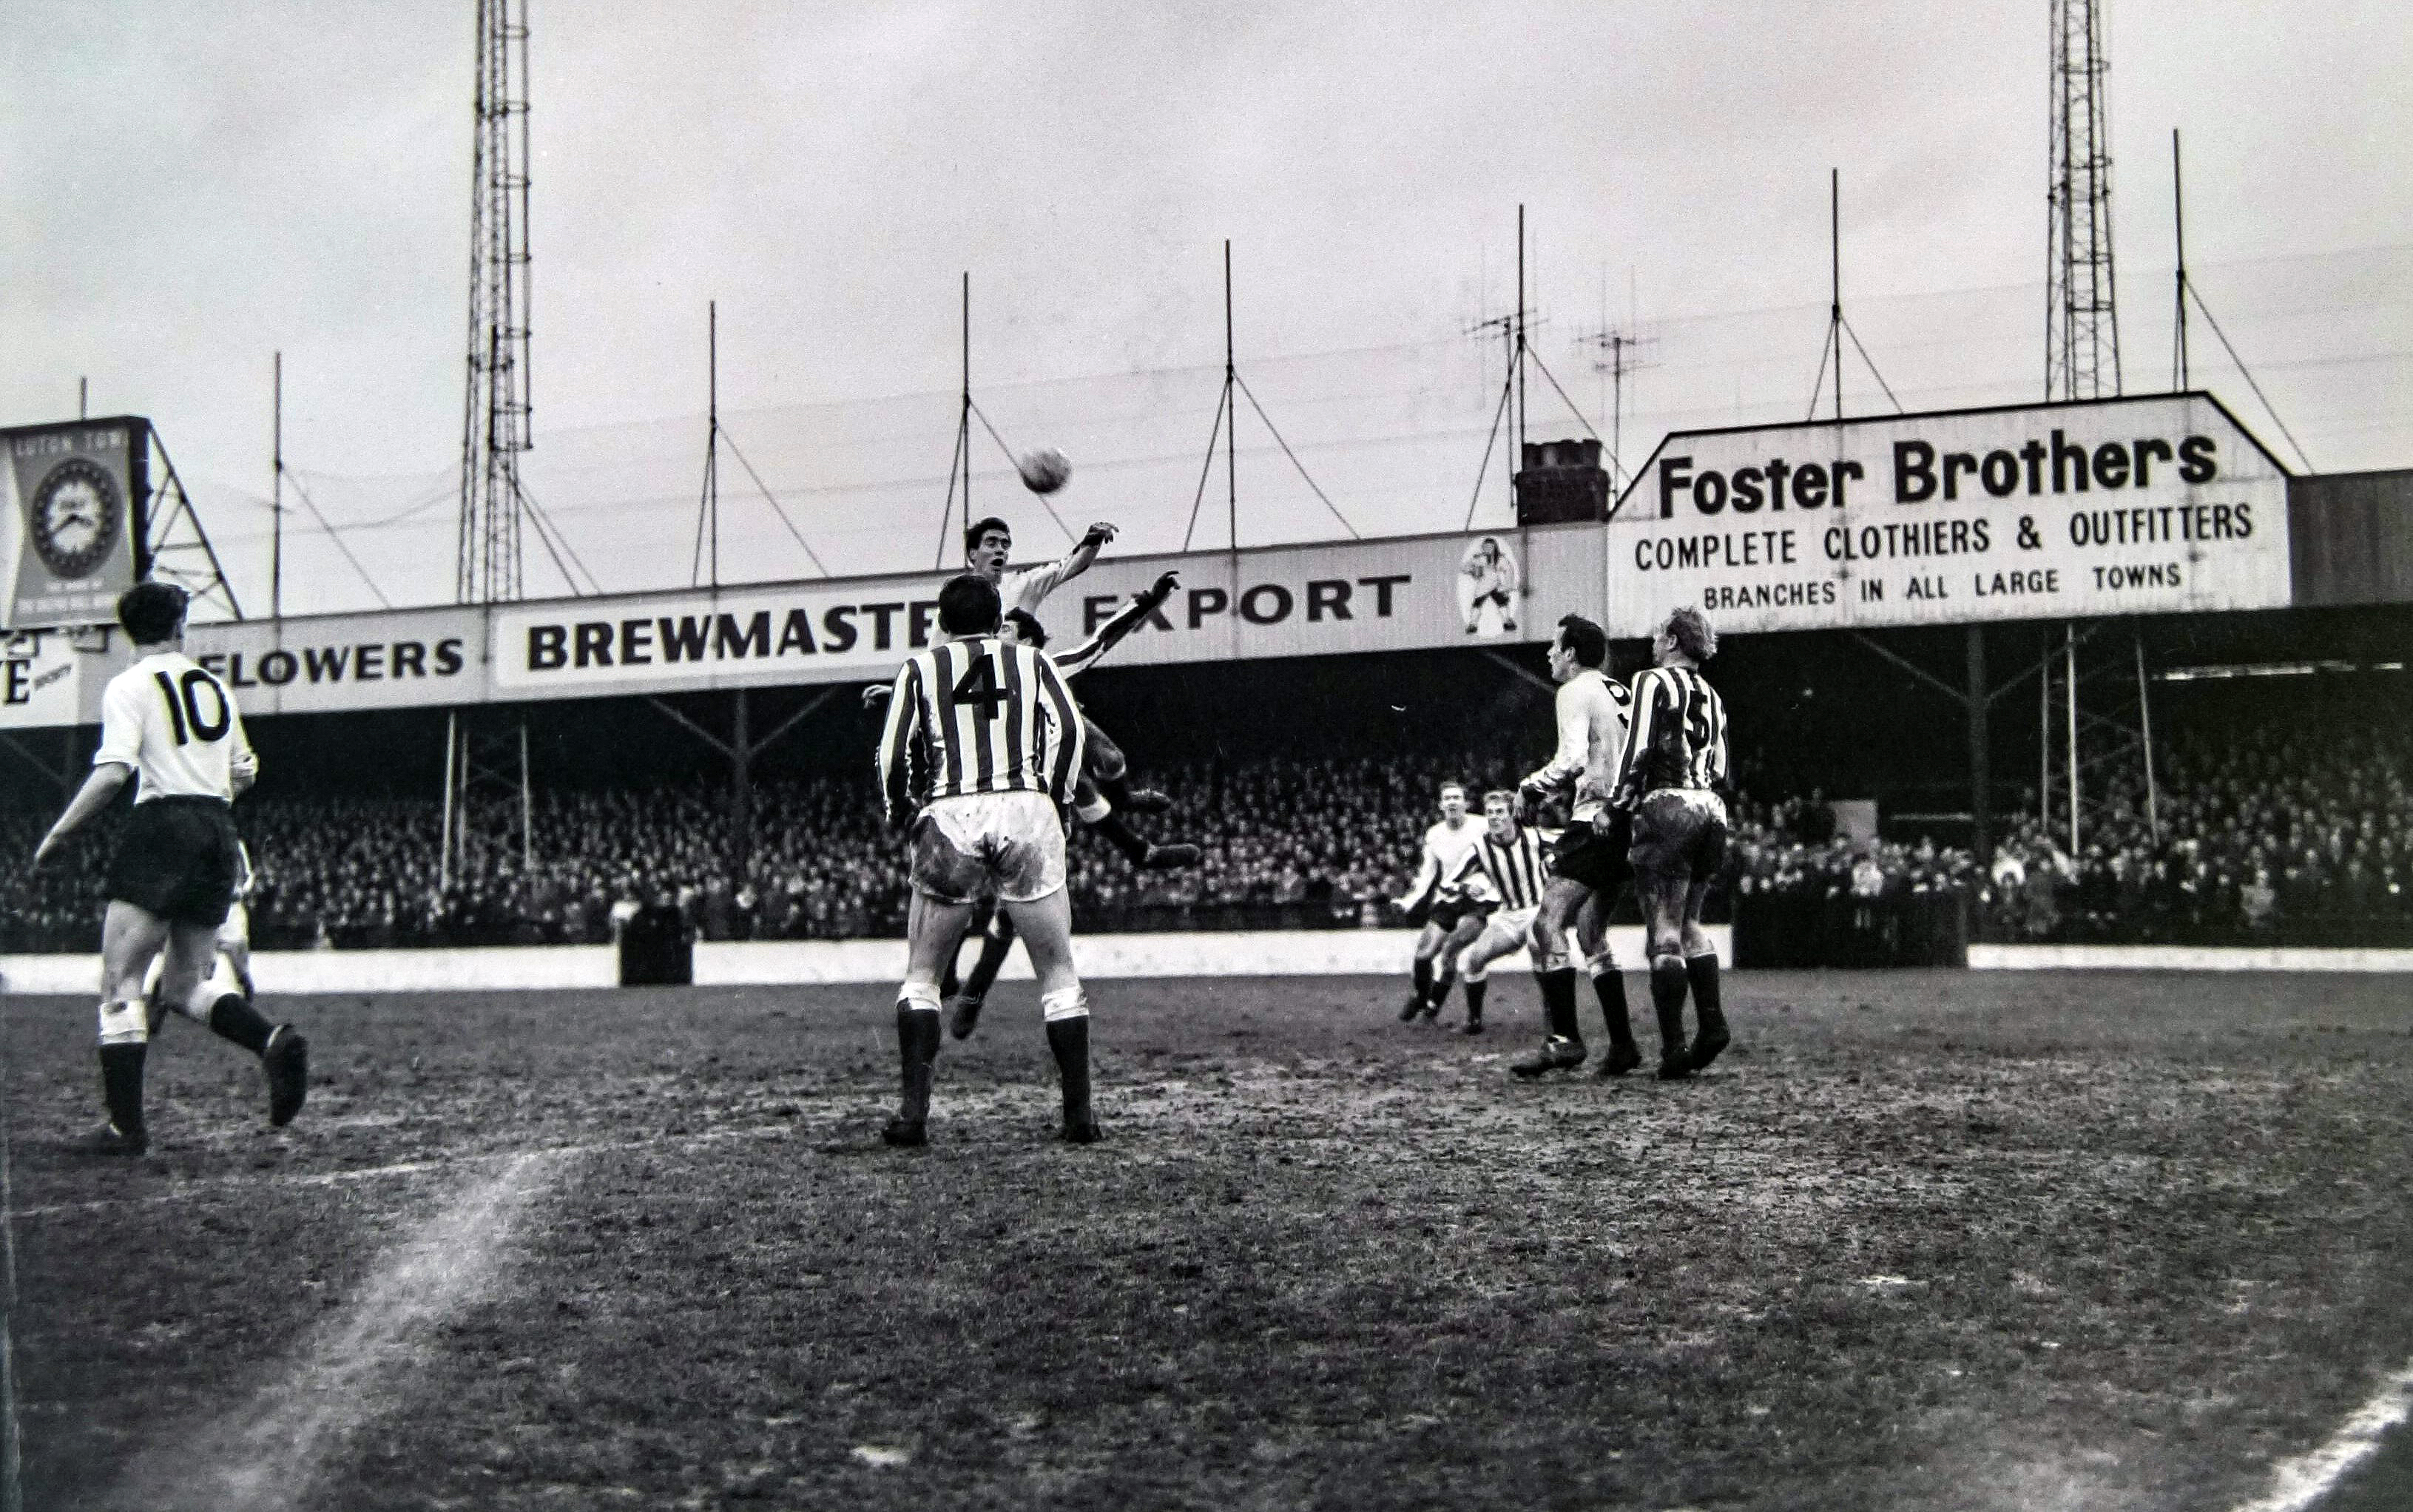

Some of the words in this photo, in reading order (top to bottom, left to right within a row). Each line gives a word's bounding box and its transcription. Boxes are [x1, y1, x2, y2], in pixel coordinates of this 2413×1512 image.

[1659, 455, 1864, 519] Foster
[1892, 429, 2217, 504] Brothers
[1635, 529, 1797, 570] COMPLETE
[1823, 517, 1990, 561] CLOTHIERS
[2017, 516, 2042, 550] &
[2069, 502, 2252, 547] OUTFITTERS
[1704, 579, 1836, 610] BRANCHES
[1860, 578, 1883, 602] IN
[1906, 573, 1948, 600] ALL
[1974, 567, 2059, 596] LARGE
[2093, 561, 2181, 590] TOWNS
[527, 599, 939, 669] BREWMASTE
[154, 669, 231, 746] 10
[953, 653, 1007, 719] 4
[1685, 689, 1709, 749] 5
